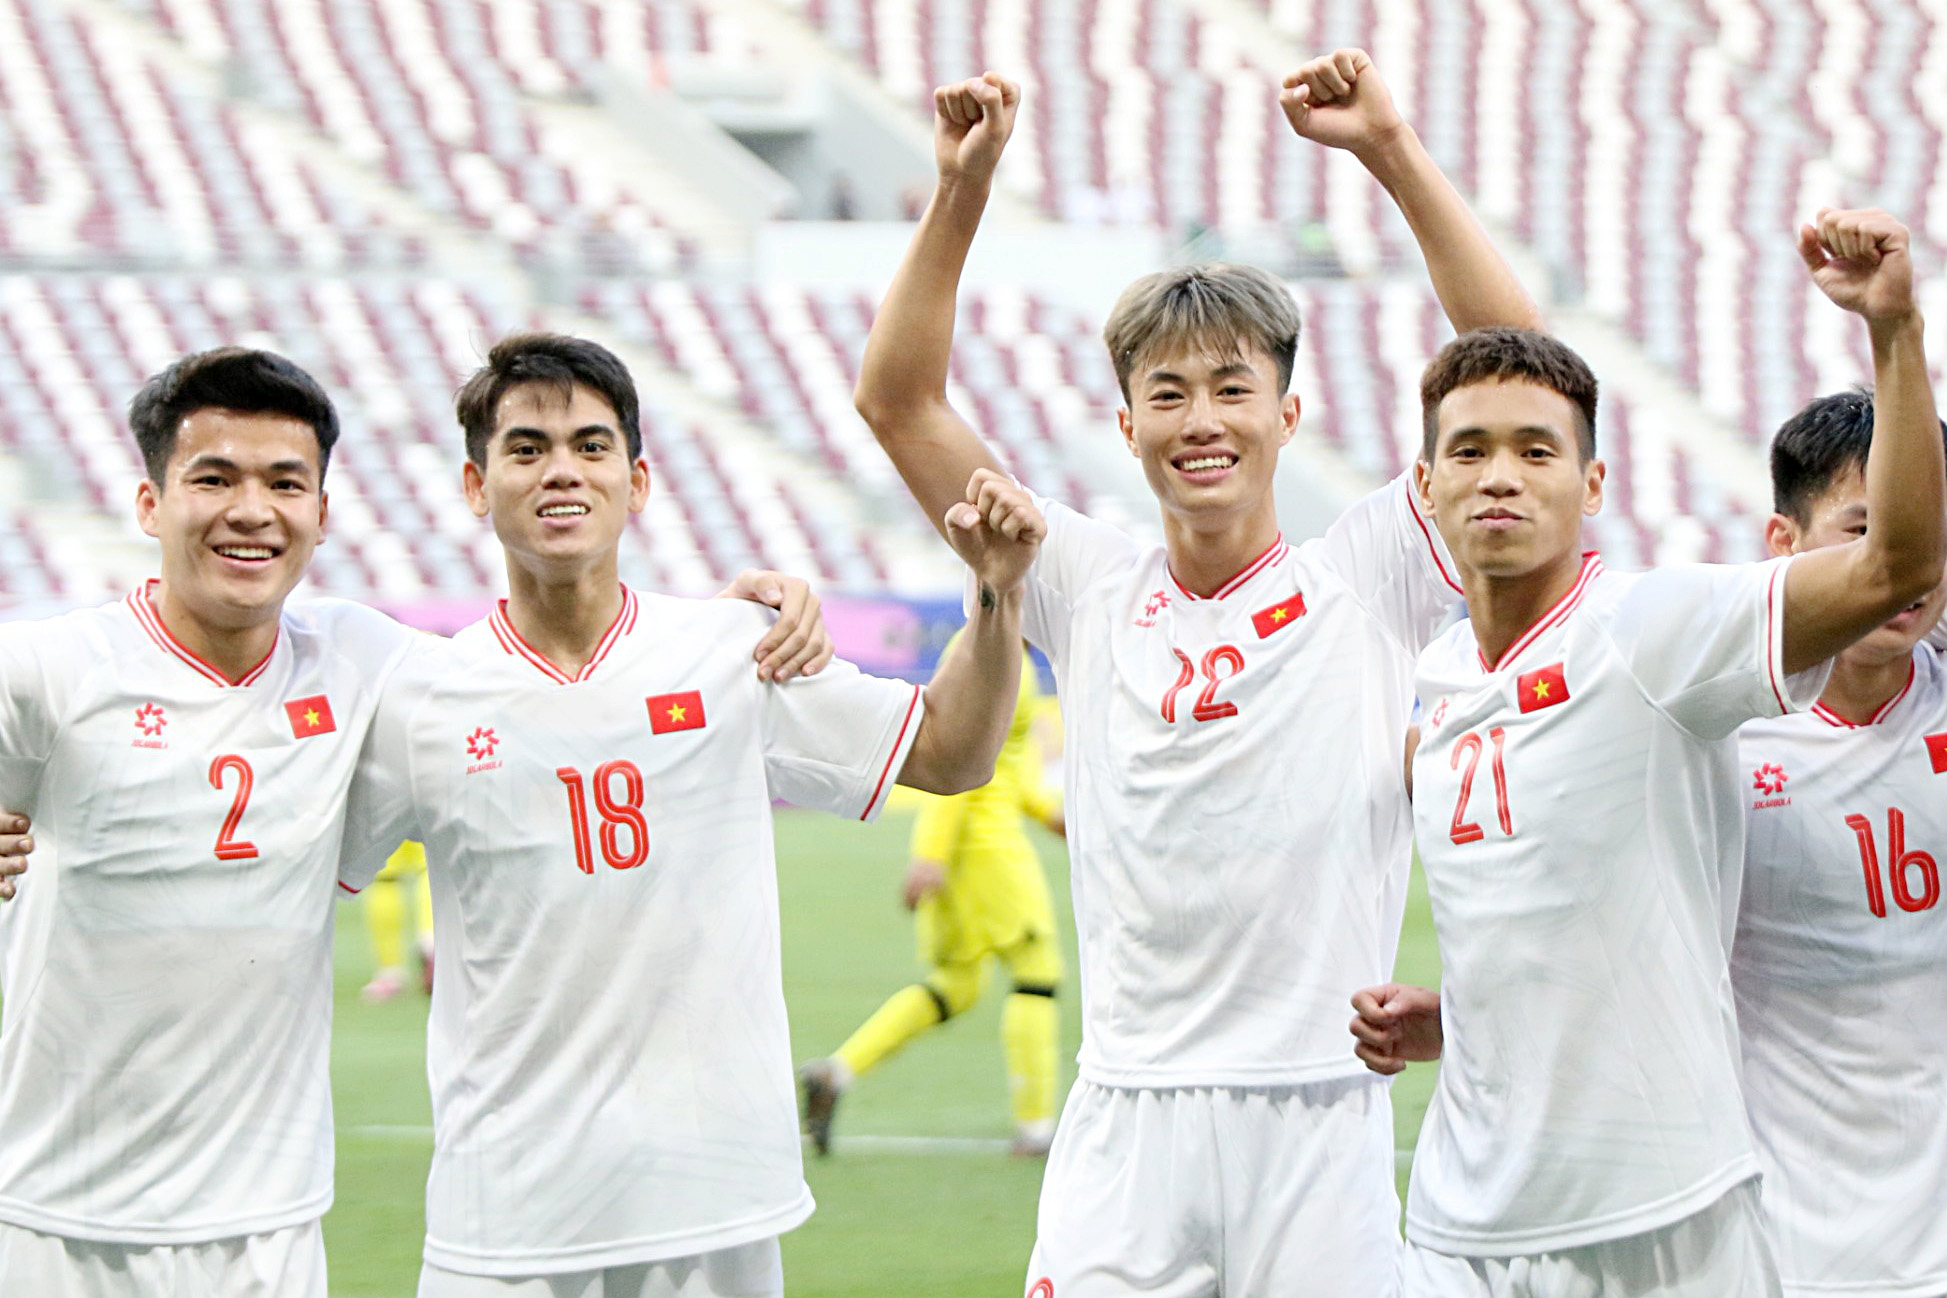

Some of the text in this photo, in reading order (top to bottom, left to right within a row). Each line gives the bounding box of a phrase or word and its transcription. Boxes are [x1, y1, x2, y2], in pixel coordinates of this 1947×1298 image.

[208, 754, 259, 860] 2
[556, 759, 650, 875] 18
[1449, 727, 1513, 846] 21
[1844, 806, 1941, 918] 16
